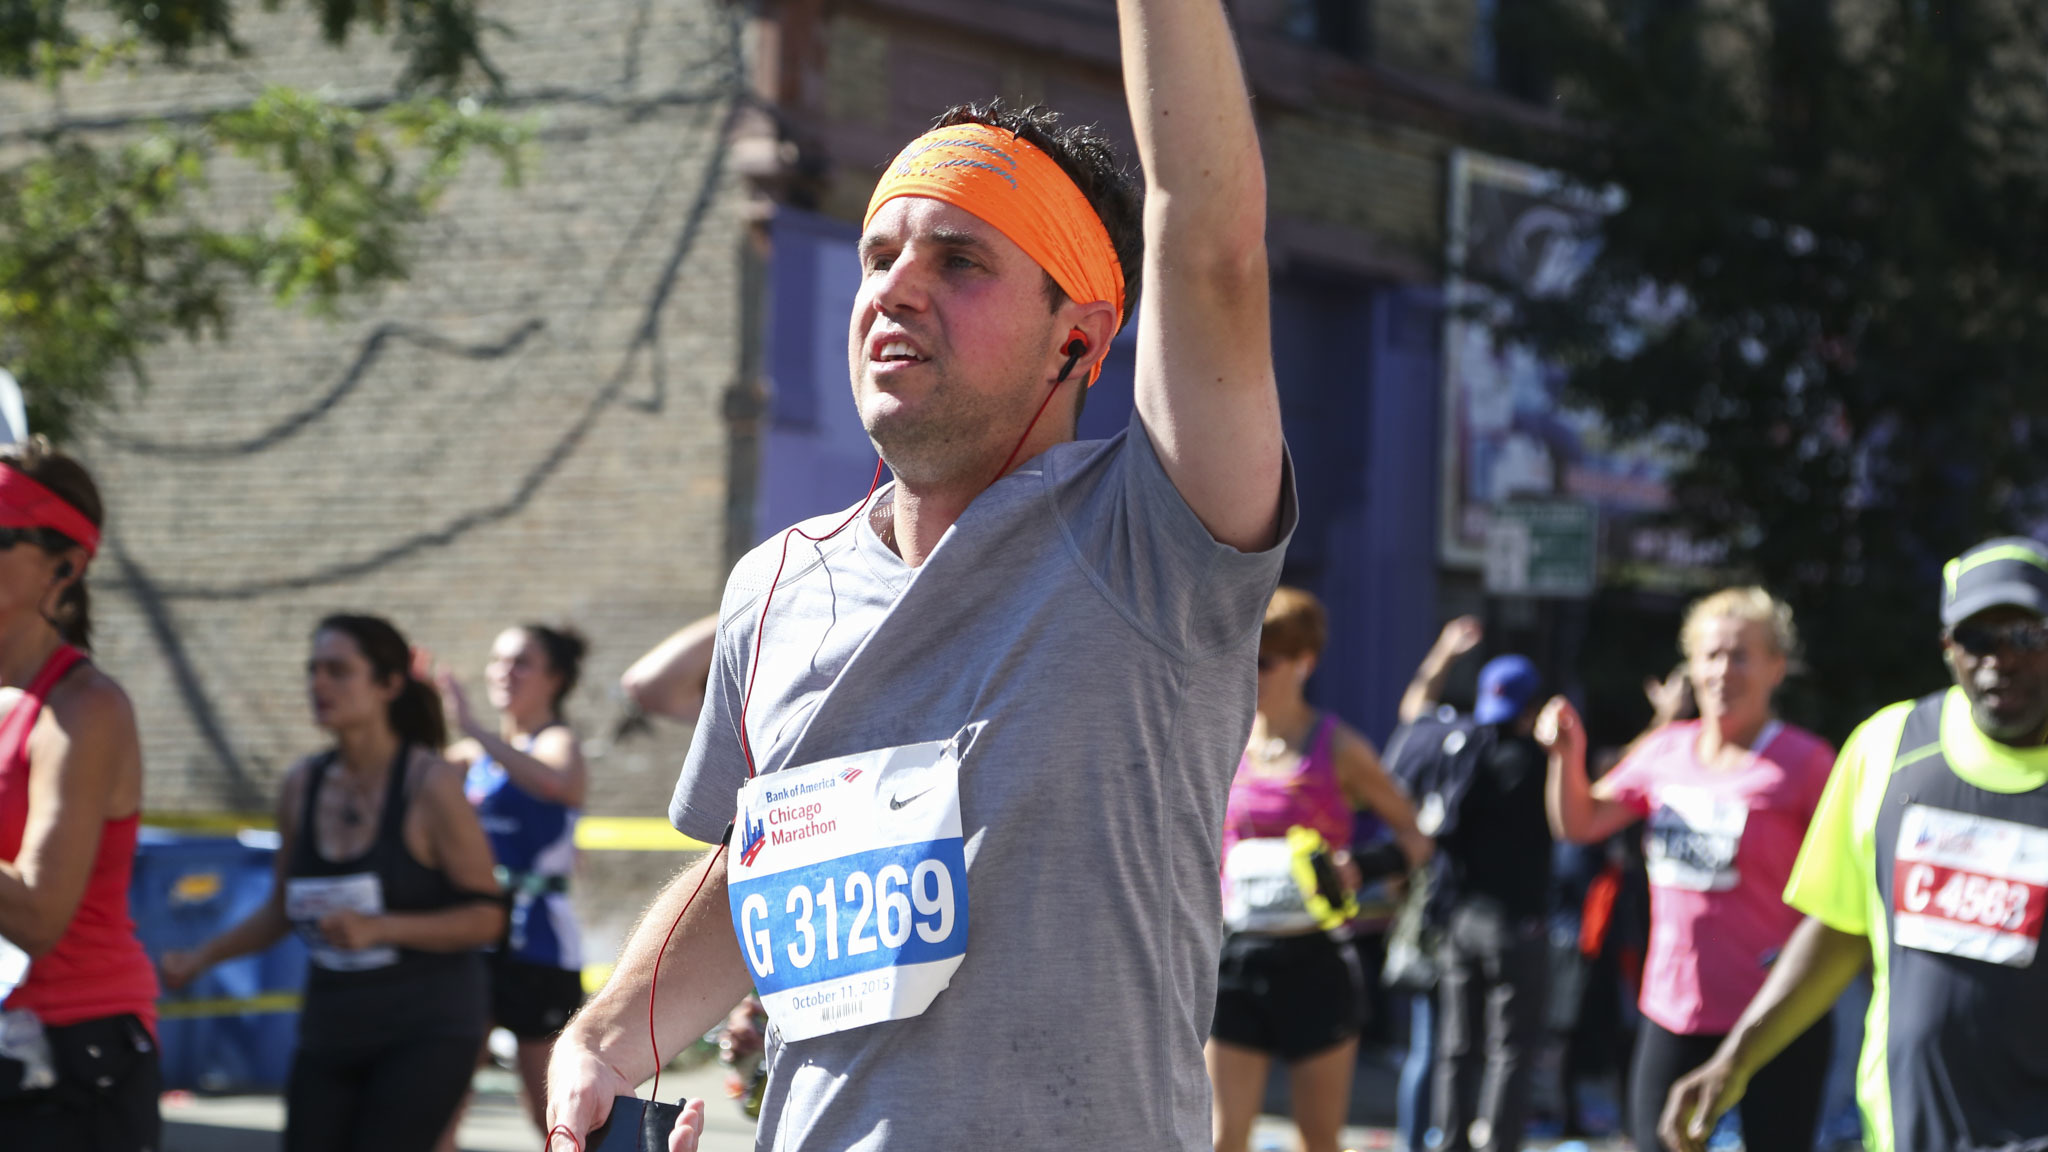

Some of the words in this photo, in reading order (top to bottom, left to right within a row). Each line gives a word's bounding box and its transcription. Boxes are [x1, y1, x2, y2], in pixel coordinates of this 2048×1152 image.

[766, 788, 789, 803] Bank
[790, 785, 799, 797] of
[800, 778, 836, 795] America
[769, 803, 822, 825] Chicago
[772, 820, 837, 847] Marathon
[1903, 863, 1936, 913] C
[741, 893, 775, 978] G
[785, 859, 956, 969] 31269
[792, 991, 837, 1010] October
[862, 977, 890, 995] 2015
